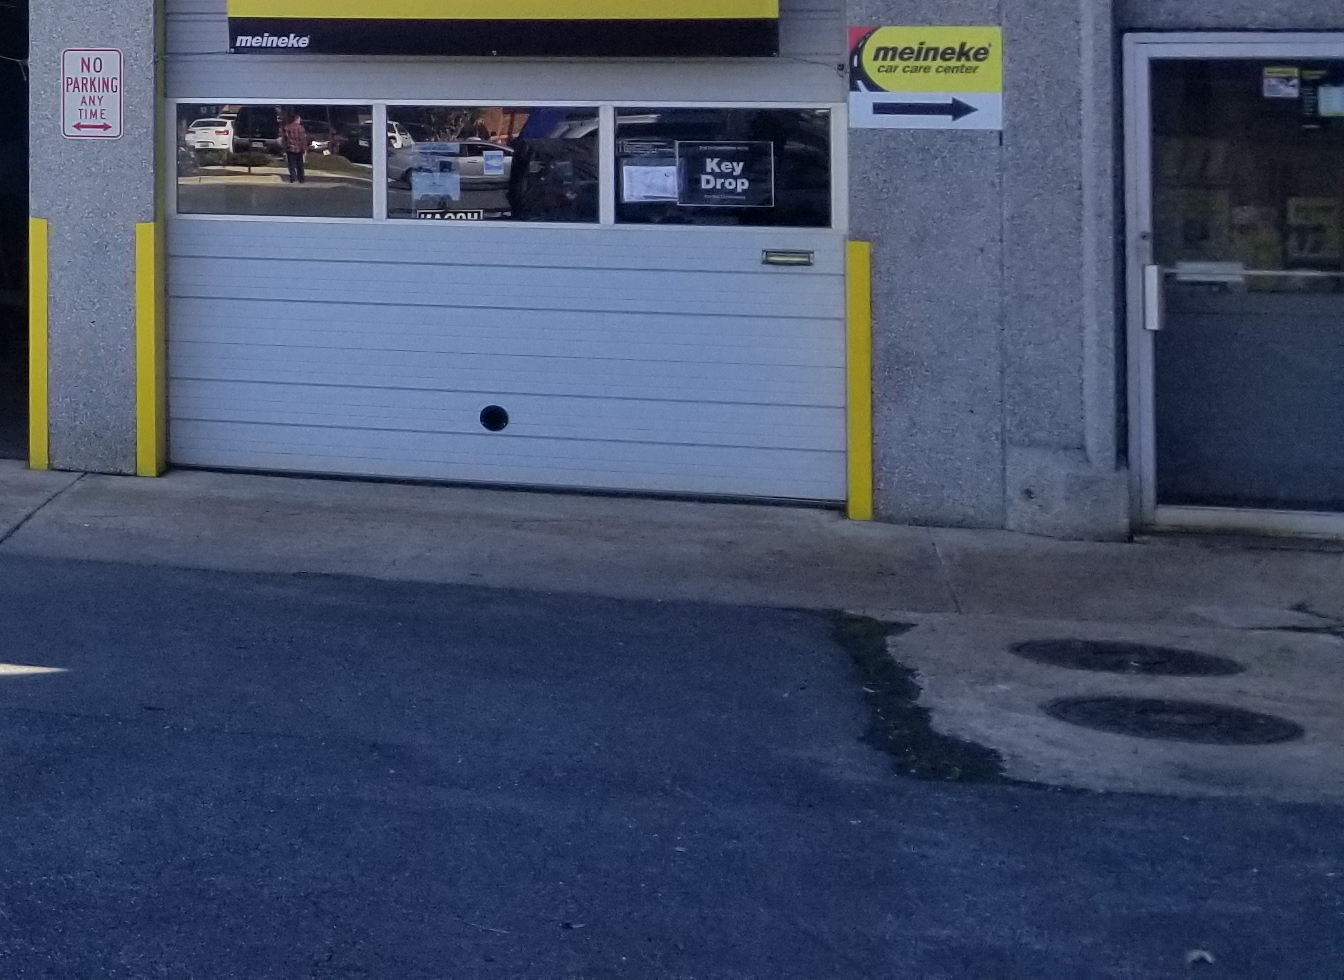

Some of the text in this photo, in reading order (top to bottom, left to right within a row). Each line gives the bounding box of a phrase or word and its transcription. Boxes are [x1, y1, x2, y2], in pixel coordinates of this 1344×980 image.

[234, 31, 310, 49] meineke
[872, 41, 990, 62] meineke
[80, 56, 103, 73] NO
[877, 63, 979, 74] car care center
[66, 76, 118, 93] PARKING
[80, 95, 104, 107] ANY
[78, 108, 107, 120] TIME
[705, 157, 745, 176] Key
[700, 174, 750, 192] Drop
